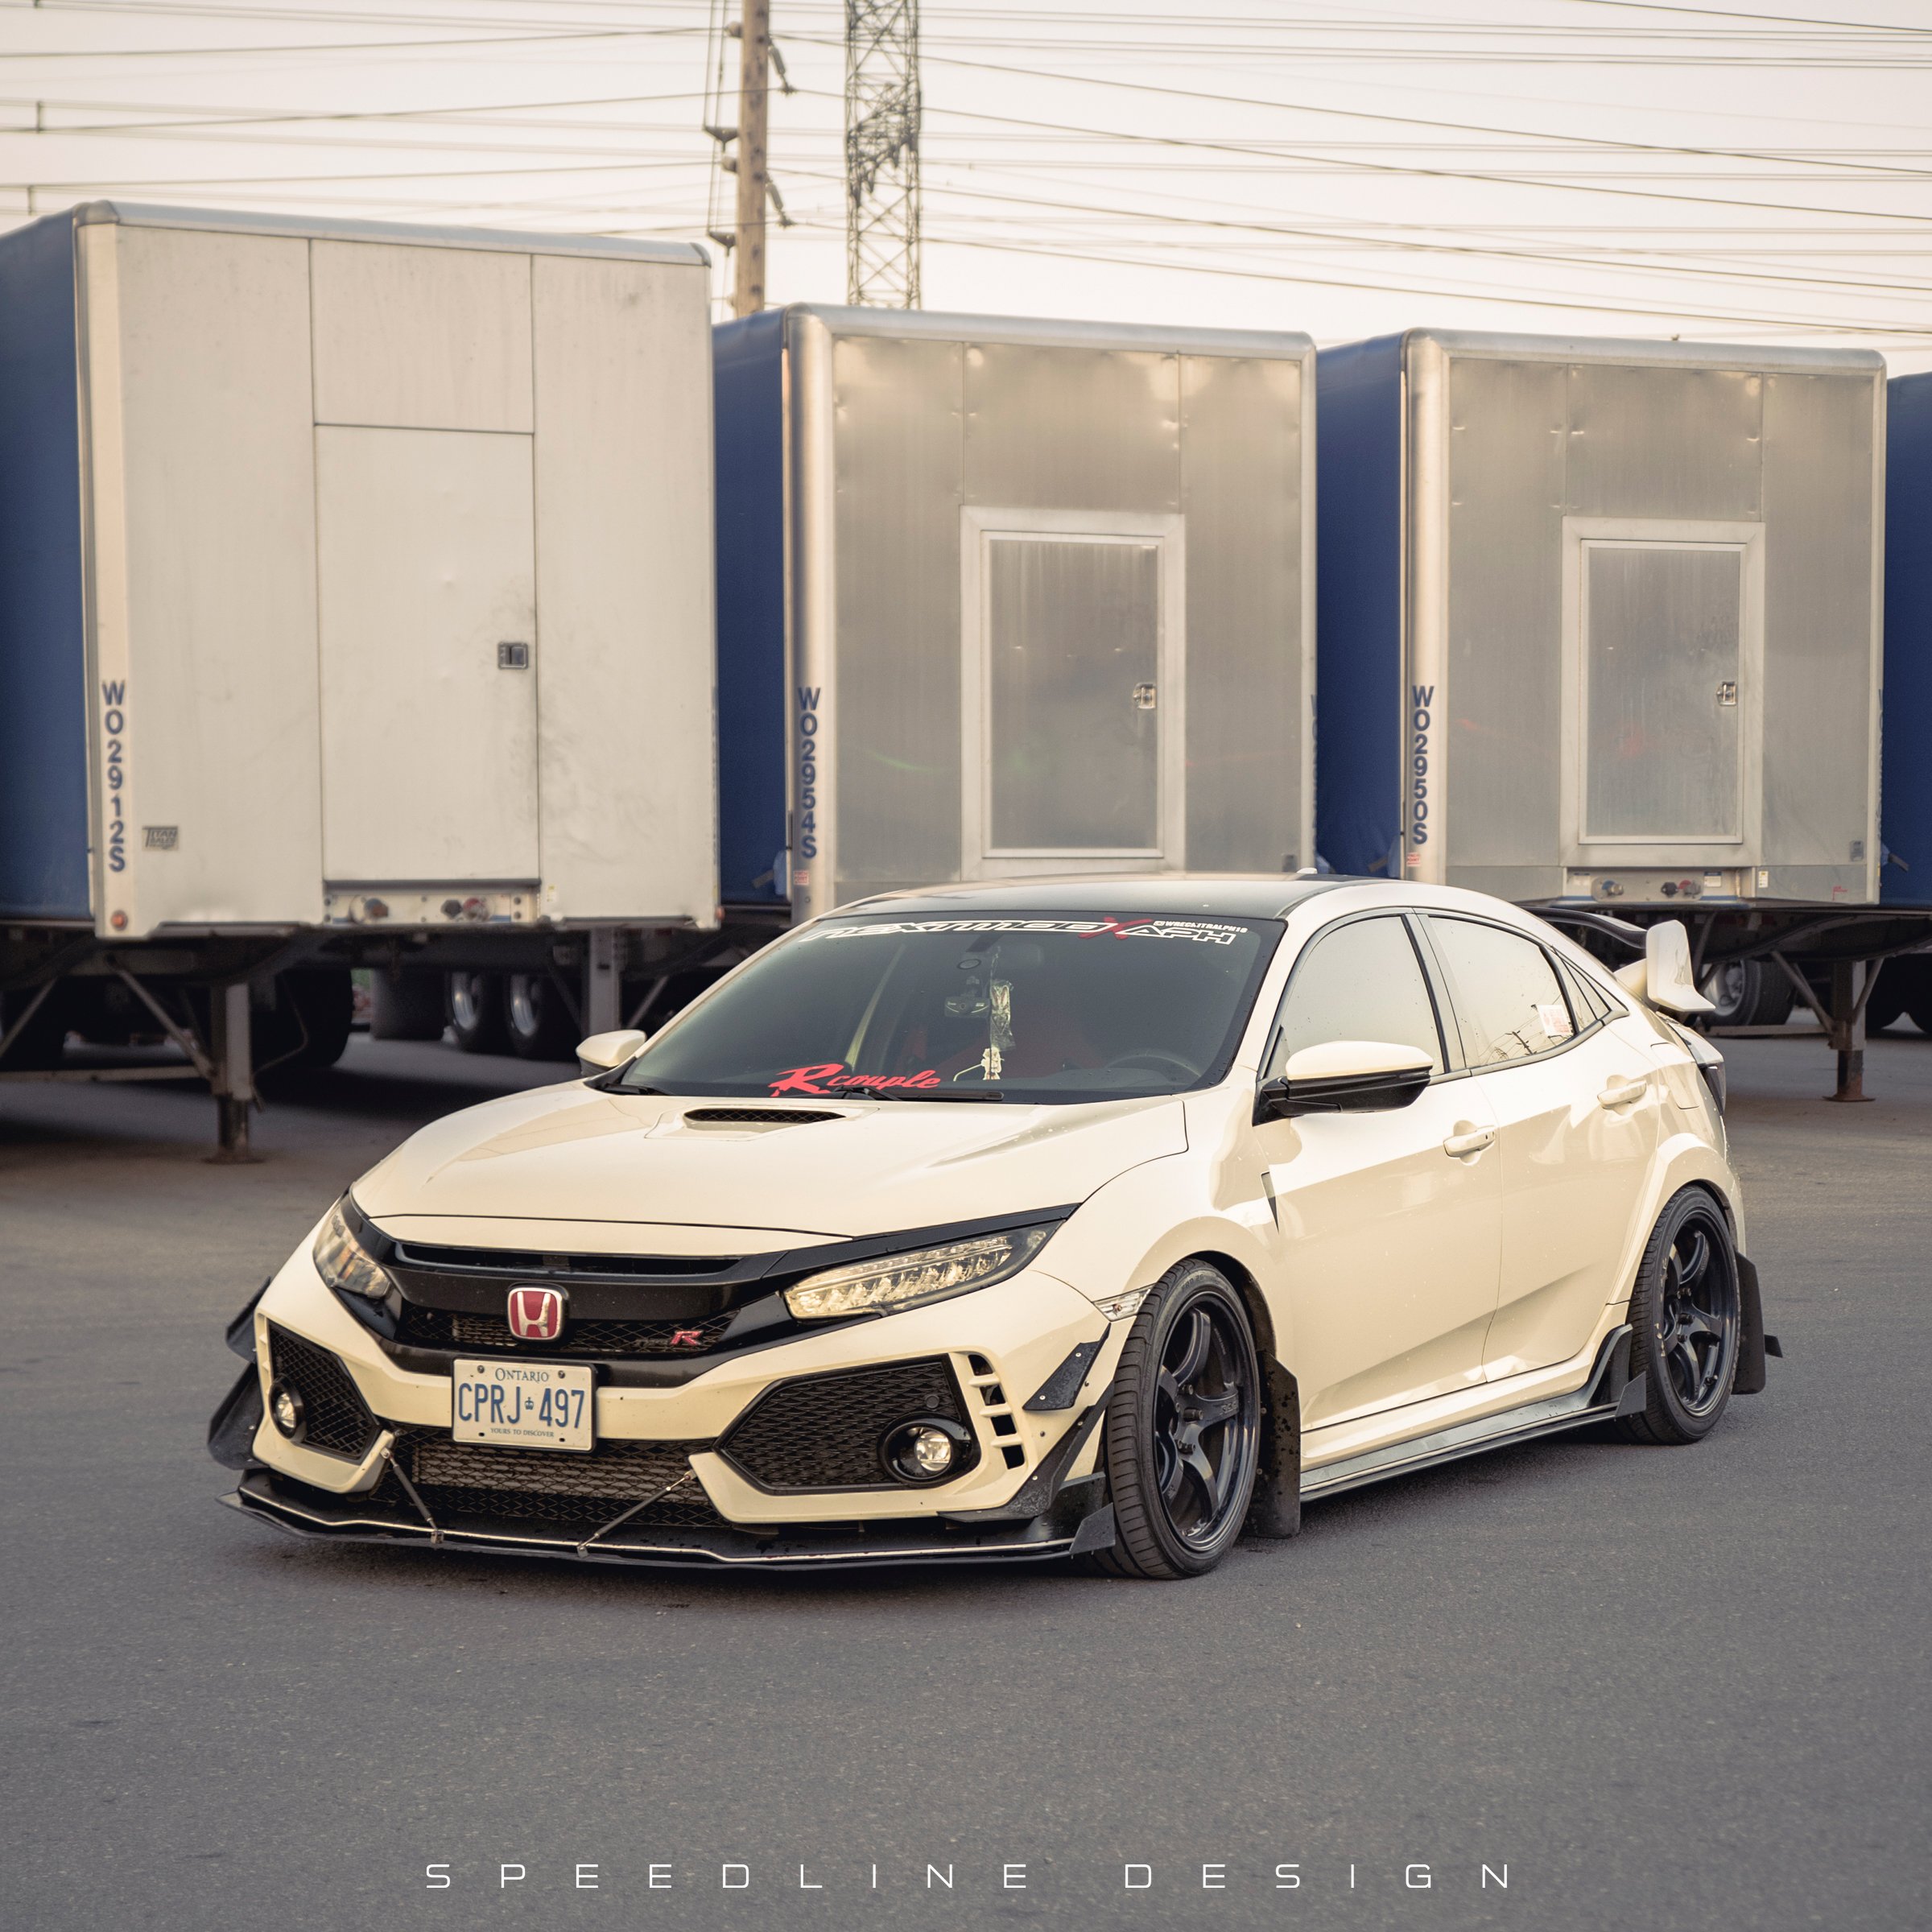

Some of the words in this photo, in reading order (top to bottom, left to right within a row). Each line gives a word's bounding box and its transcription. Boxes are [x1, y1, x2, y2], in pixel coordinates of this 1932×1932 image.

[495, 1368, 549, 1383] ONTARIO
[459, 1382, 521, 1424] CPRJ
[539, 1388, 584, 1429] 497
[523, 1430, 555, 1438] DISCOVER
